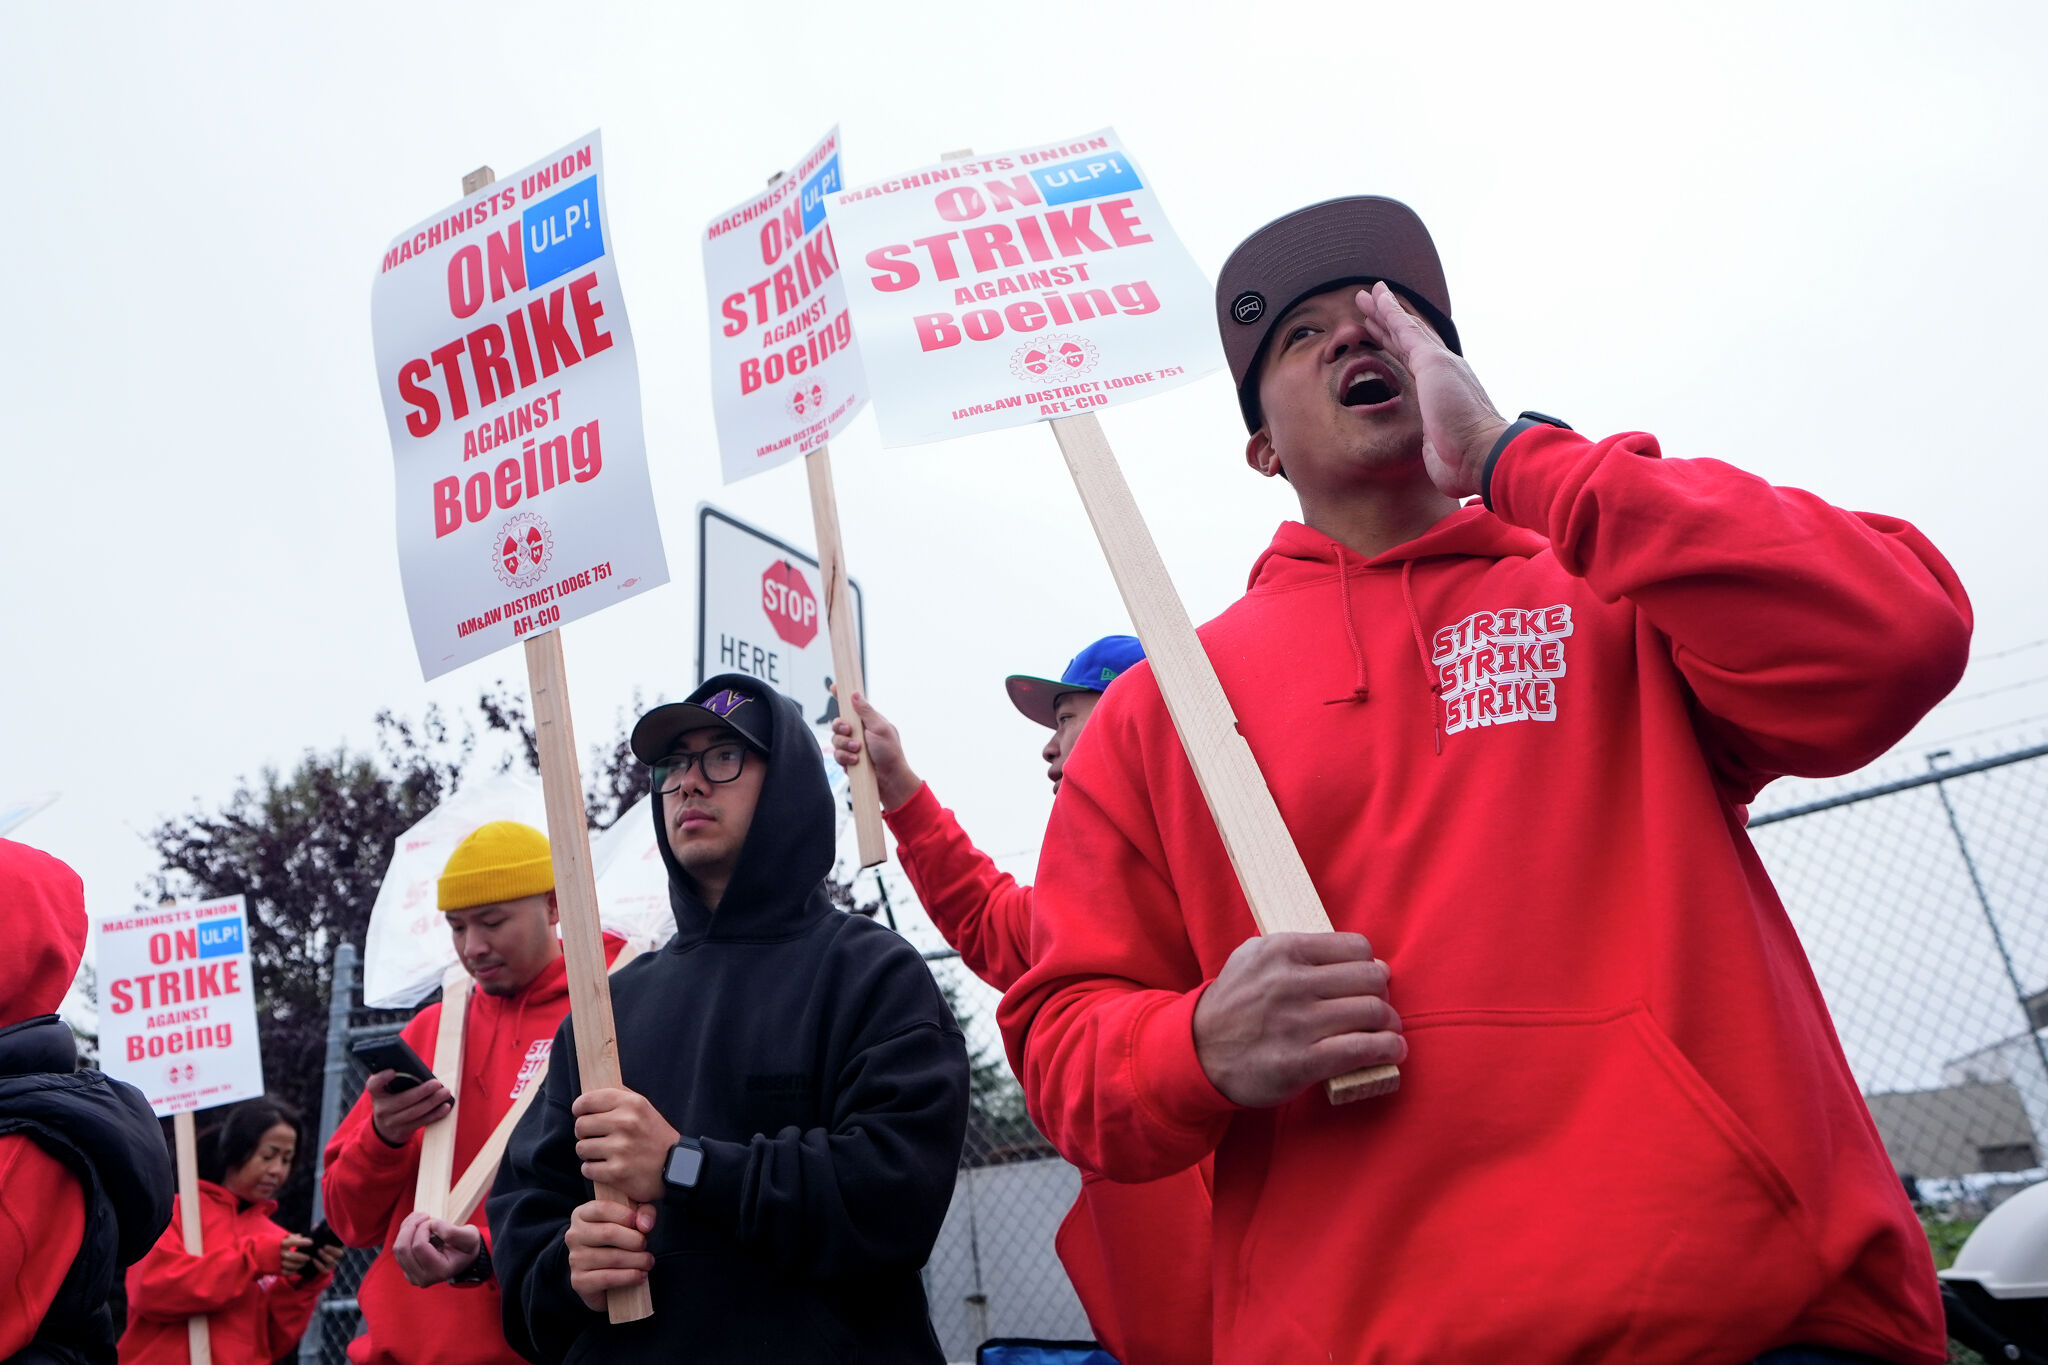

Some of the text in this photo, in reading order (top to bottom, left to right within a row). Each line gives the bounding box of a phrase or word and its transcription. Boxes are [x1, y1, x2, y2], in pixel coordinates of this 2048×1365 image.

[708, 135, 835, 240] MACHINISTS UNION
[804, 168, 837, 212] ULP!
[839, 136, 1109, 206] MACHINISTS UNION
[934, 174, 1042, 223] ON
[1043, 160, 1122, 188] ULP!
[382, 145, 592, 274] MACHINISTS UNION
[531, 198, 590, 253] ULP!
[760, 196, 803, 266] ON
[447, 219, 527, 319] ON
[865, 198, 1154, 293] STRIKE
[954, 262, 1089, 306] AGAINST
[763, 294, 827, 349] AGAINST
[913, 280, 1161, 352] Boeing
[398, 271, 613, 438] STRIKE
[740, 308, 852, 396] Boeing
[952, 365, 1185, 420] IAM&AW DISTRICT LODGE 751
[1039, 393, 1109, 416] AFL-CIO
[463, 389, 562, 462] AGAINST
[793, 418, 827, 443] DISTRICT
[433, 419, 602, 539] Boeing
[457, 606, 502, 638] IAM&AW
[504, 585, 555, 618] DISTRICT
[556, 570, 591, 597] LODGE
[592, 561, 612, 583] 751
[513, 604, 560, 637] AFL-CIO
[764, 579, 816, 627] STOP
[720, 632, 780, 684] HERE
[1433, 604, 1573, 664] STRIKE
[1440, 639, 1565, 699] STRIKE
[1446, 679, 1556, 734] STRIKE
[102, 903, 238, 933] MACHINISTS UNION
[202, 926, 238, 945] ULP!
[150, 928, 198, 965] ON
[110, 960, 241, 1015] STRIKE
[127, 1023, 232, 1062] Boeing
[147, 1006, 209, 1029] AGAINST
